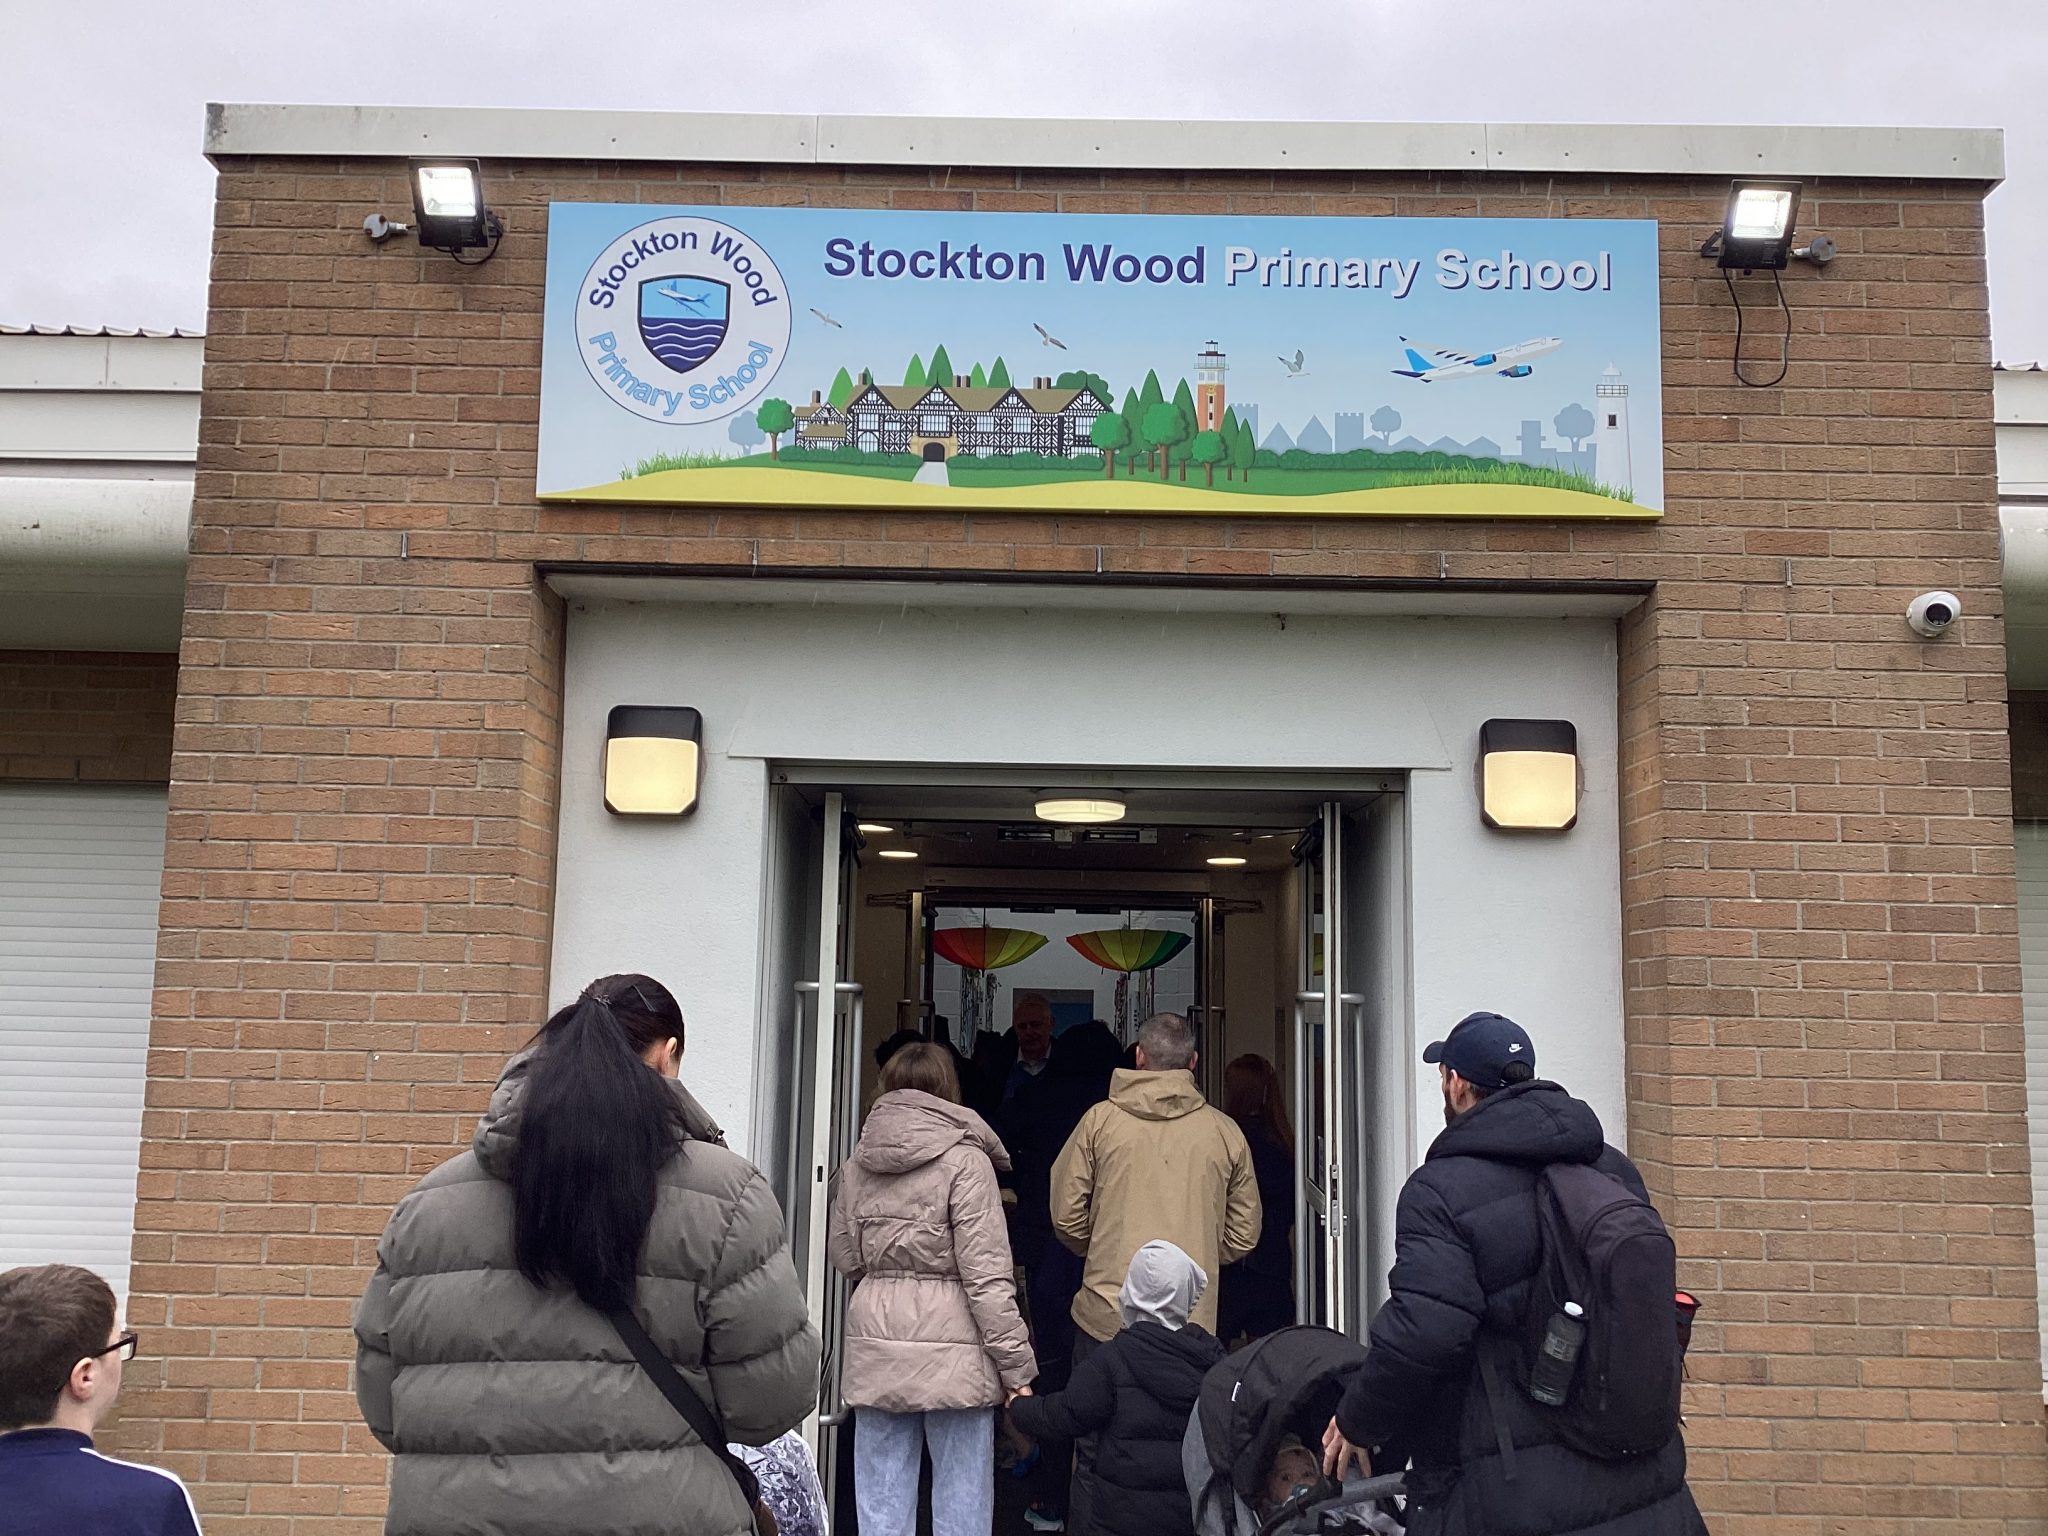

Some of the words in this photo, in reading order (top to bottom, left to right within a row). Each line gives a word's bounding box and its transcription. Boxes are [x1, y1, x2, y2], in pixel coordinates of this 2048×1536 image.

[589, 231, 698, 309] Stockton
[709, 231, 778, 306] Wood
[824, 238, 1045, 281] Stockton
[1063, 244, 1205, 284] Wood
[1225, 246, 1419, 298] Primary
[1434, 249, 1612, 291] School
[590, 331, 683, 416] Primary
[689, 341, 774, 410] School
